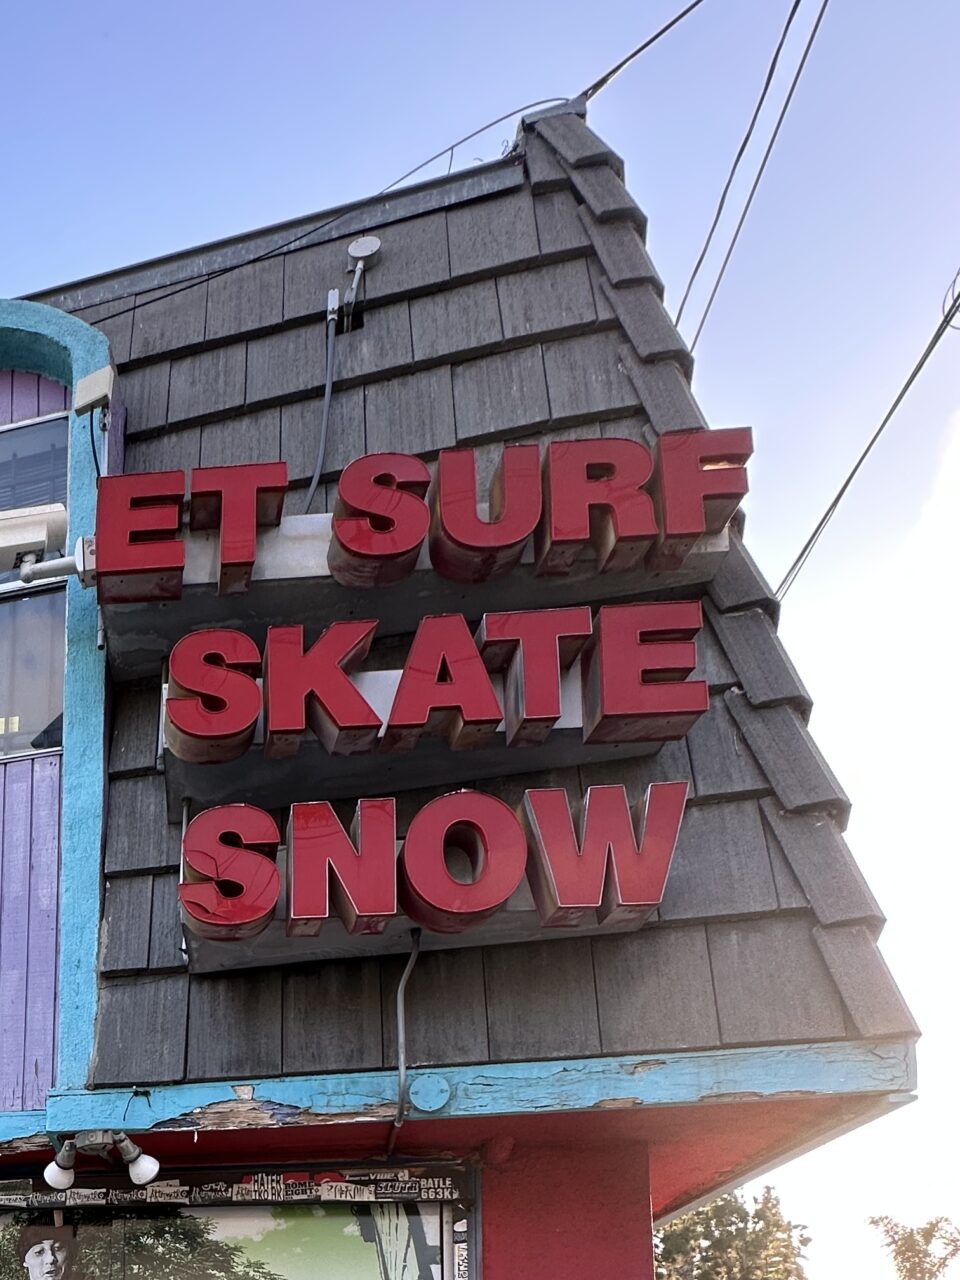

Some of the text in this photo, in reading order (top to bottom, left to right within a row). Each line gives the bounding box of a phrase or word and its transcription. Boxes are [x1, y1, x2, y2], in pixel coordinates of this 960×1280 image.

[96, 427, 753, 585] ET SURF
[166, 601, 710, 748] SKATE
[178, 781, 689, 930] SNOW
[421, 1188, 452, 1199] 663K
